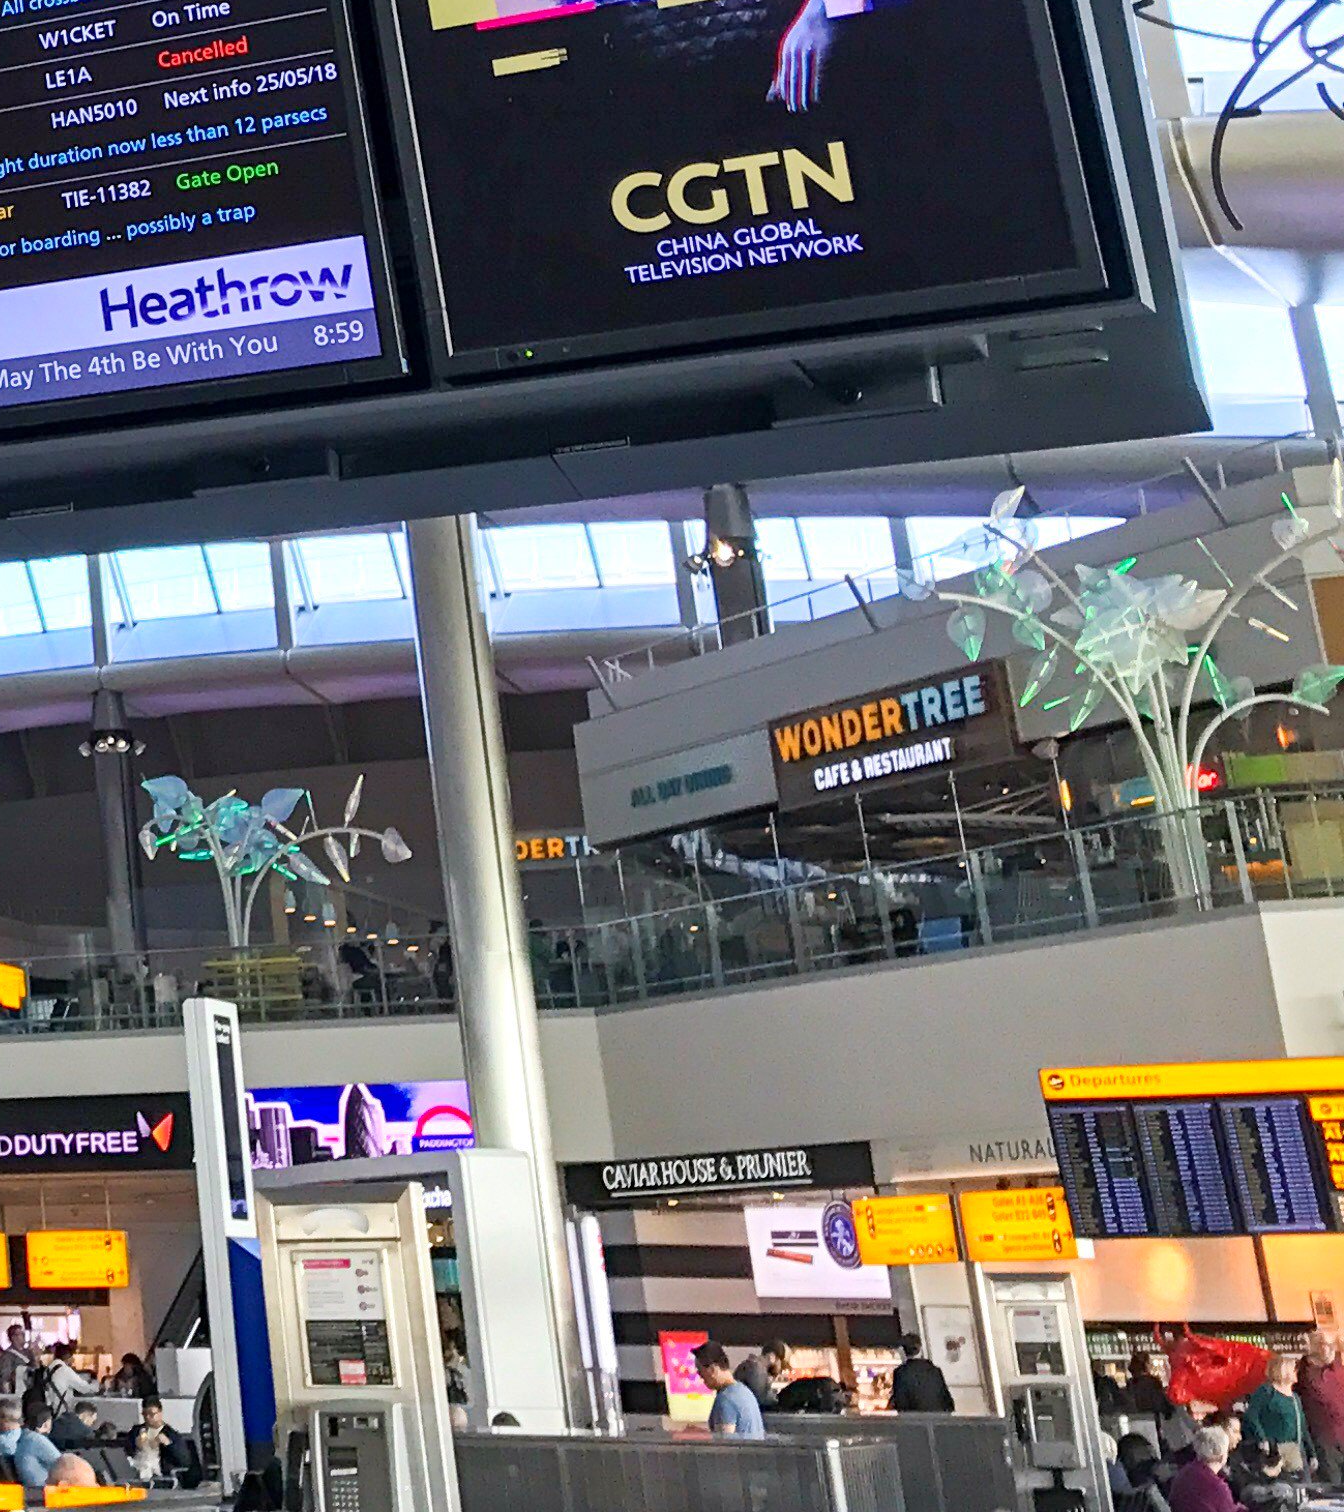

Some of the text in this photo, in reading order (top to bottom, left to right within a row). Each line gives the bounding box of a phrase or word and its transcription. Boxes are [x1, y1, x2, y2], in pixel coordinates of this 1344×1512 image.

[38, 19, 116, 49] W1CKET
[151, 10, 180, 27] On
[183, 2, 230, 21] Time
[157, 35, 248, 68] Cancelled
[51, 98, 138, 128] HAN5010
[163, 87, 209, 109] Next
[212, 78, 251, 100] info
[255, 62, 337, 92] 25/05/18
[61, 179, 151, 208] TIE-11382
[176, 171, 221, 189] Gate
[226, 162, 279, 184] Open
[611, 140, 855, 234] CGTN
[624, 233, 863, 285] TELEVISION NETWORK
[656, 218, 822, 258] CHINA GLOBAL
[99, 264, 353, 331] Heathrow
[38, 360, 81, 382] The
[88, 352, 125, 375] 4th
[132, 350, 160, 370] Be
[165, 338, 223, 365] With
[228, 335, 278, 356] You
[774, 675, 986, 763] WONDERTREE
[814, 737, 953, 791] CAFE & RESTAURANT
[603, 1150, 812, 1190] CAVIAR HOUSE & PRUNIER
